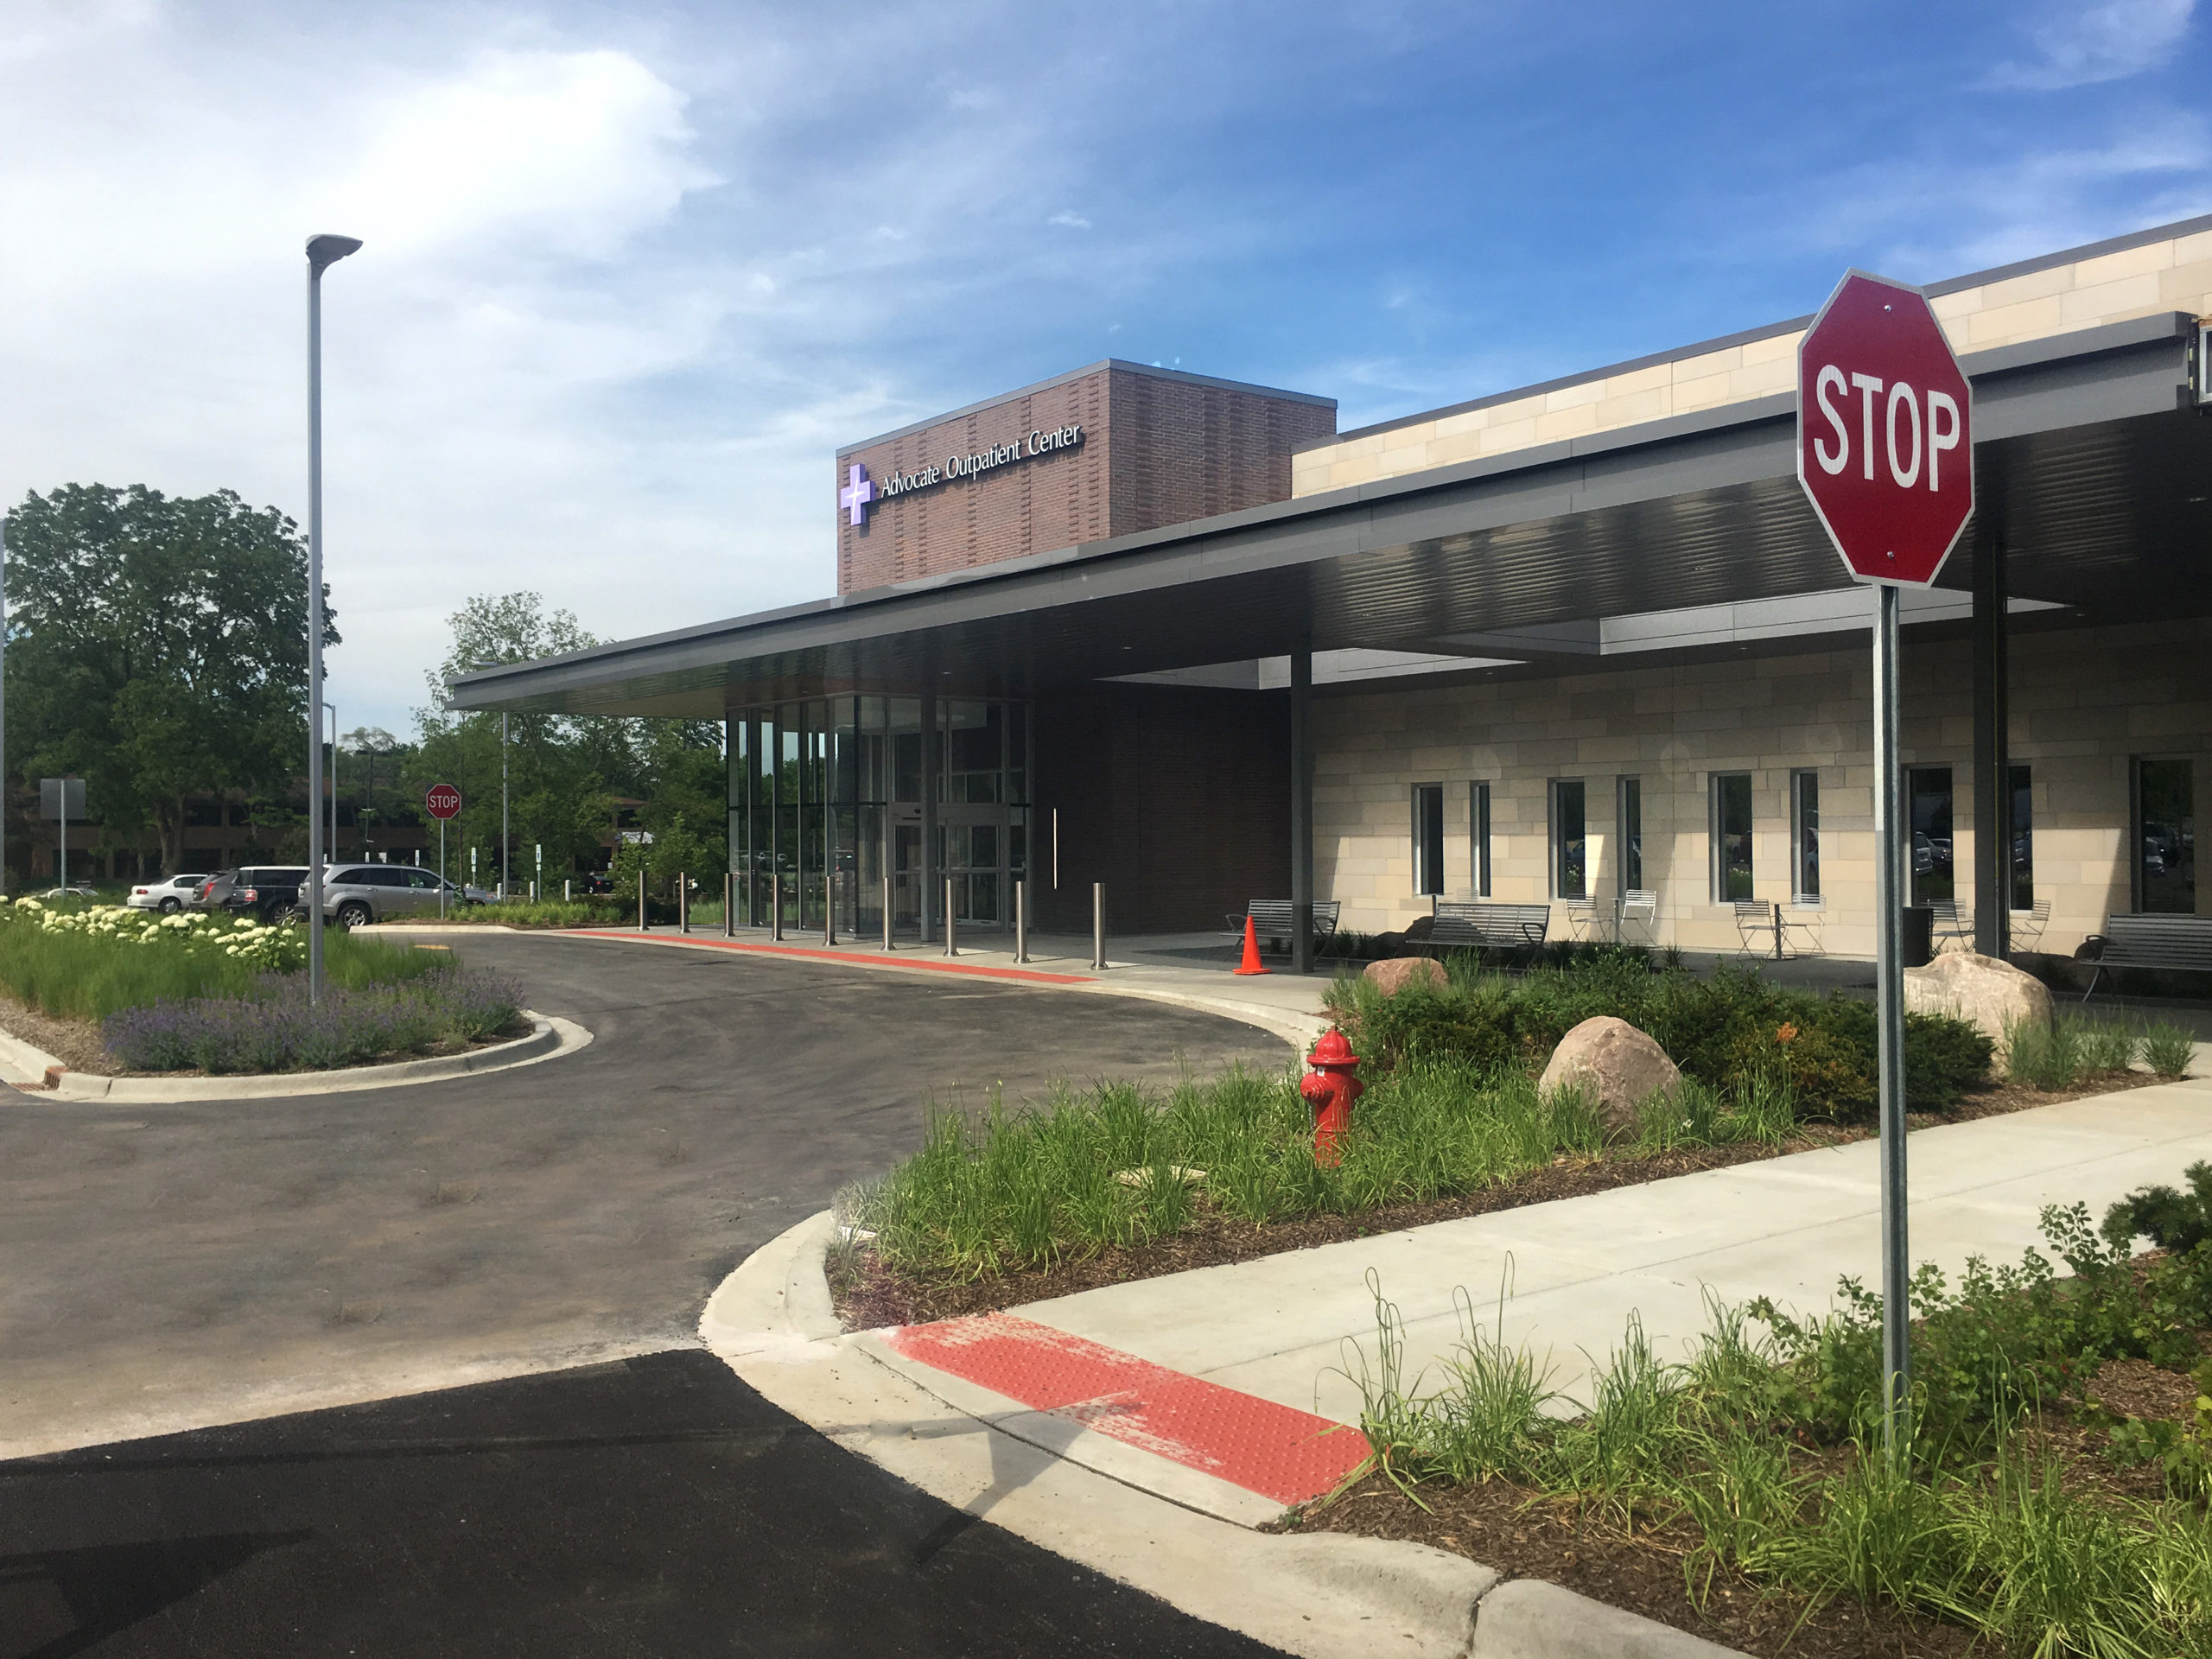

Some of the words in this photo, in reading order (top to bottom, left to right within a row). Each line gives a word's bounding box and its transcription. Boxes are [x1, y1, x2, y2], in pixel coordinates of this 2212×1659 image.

[880, 465, 939, 498] Advocate
[946, 439, 1021, 480] Outpatient
[1028, 425, 1080, 456] Center
[1814, 364, 1961, 492] STOP
[429, 795, 458, 808] STOP
